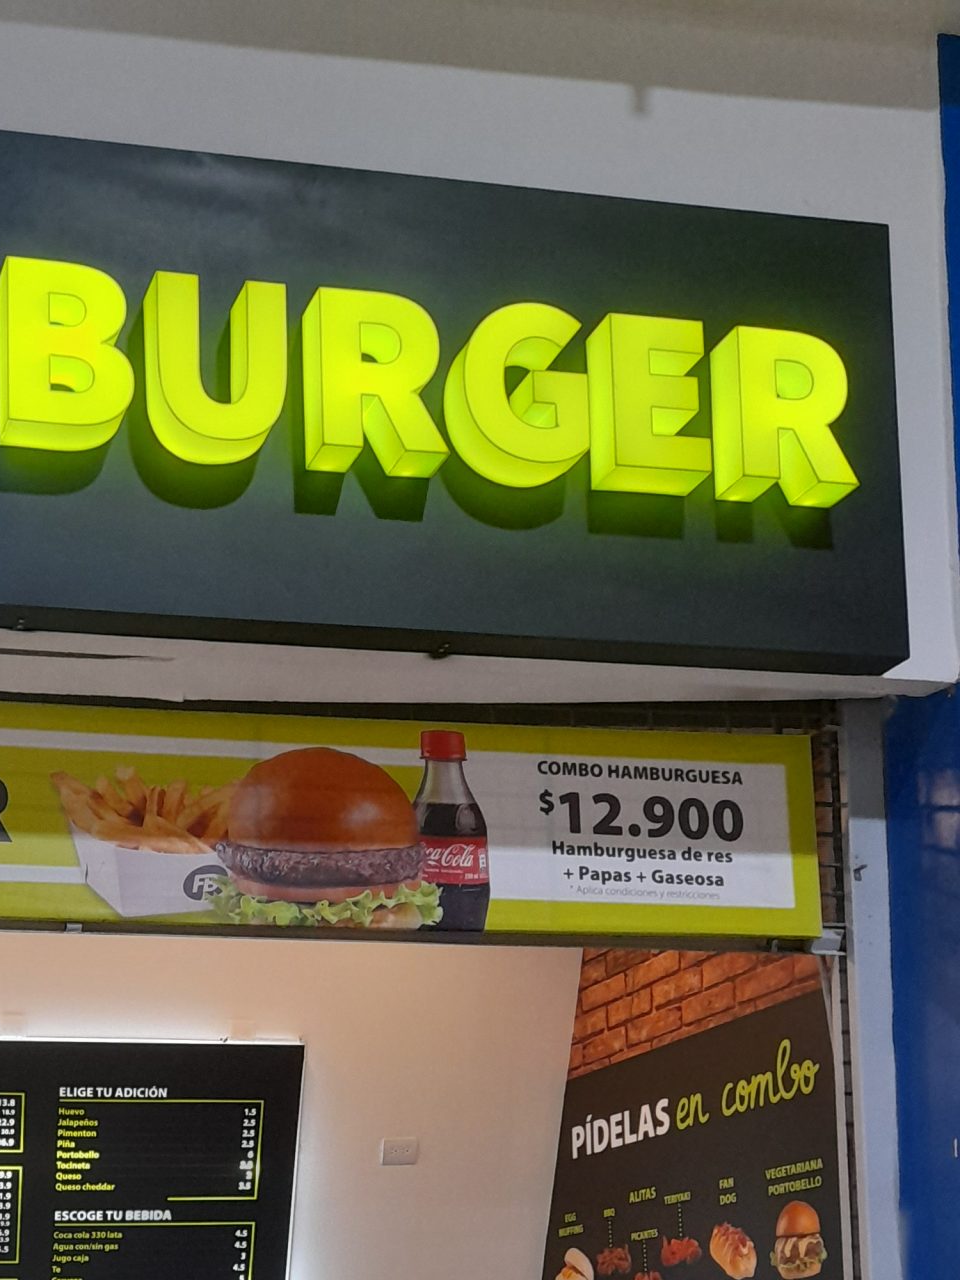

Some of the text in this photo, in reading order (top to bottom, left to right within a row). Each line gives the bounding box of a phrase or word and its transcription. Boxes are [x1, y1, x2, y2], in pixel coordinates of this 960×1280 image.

[537, 760, 744, 786] COMBO HAMBURGUESA
[538, 789, 744, 842] $12.900
[552, 840, 733, 864] Hamburguesa de res
[578, 866, 724, 887] Papas Gaseosa
[576, 885, 720, 900] Aplica condiciones restricciones
[59, 1085, 168, 1098] ELIGE TU ADICIÓN
[571, 1038, 819, 1160] PÍDELAS en combo
[58, 1107, 85, 1115] Huevo
[244, 1108, 256, 1116] 1.5
[57, 1118, 99, 1128] Jalapeños
[243, 1119, 256, 1127] 2.5
[57, 1129, 97, 1137] Pimenton
[241, 1129, 255, 1138] 2.5
[56, 1139, 76, 1148] Piña
[56, 1150, 100, 1159] Portobello
[56, 1161, 91, 1170] Tocineta
[765, 1158, 824, 1181] VEGETARIANA
[55, 1172, 82, 1181] Queso
[55, 1182, 116, 1191] Queso cheddar
[719, 1177, 735, 1190] FAN
[767, 1176, 822, 1197] PORTOBELLO
[629, 1186, 657, 1204] ALITAS
[719, 1193, 737, 1205] DOG
[54, 1209, 172, 1221] ESCOGE TU BEBIDA
[53, 1231, 123, 1239] Coca cola 330 lata
[52, 1243, 74, 1252] Agua
[104, 1244, 119, 1252] gas
[52, 1254, 90, 1263] Jugo caja
[232, 1263, 246, 1271] 4.5
